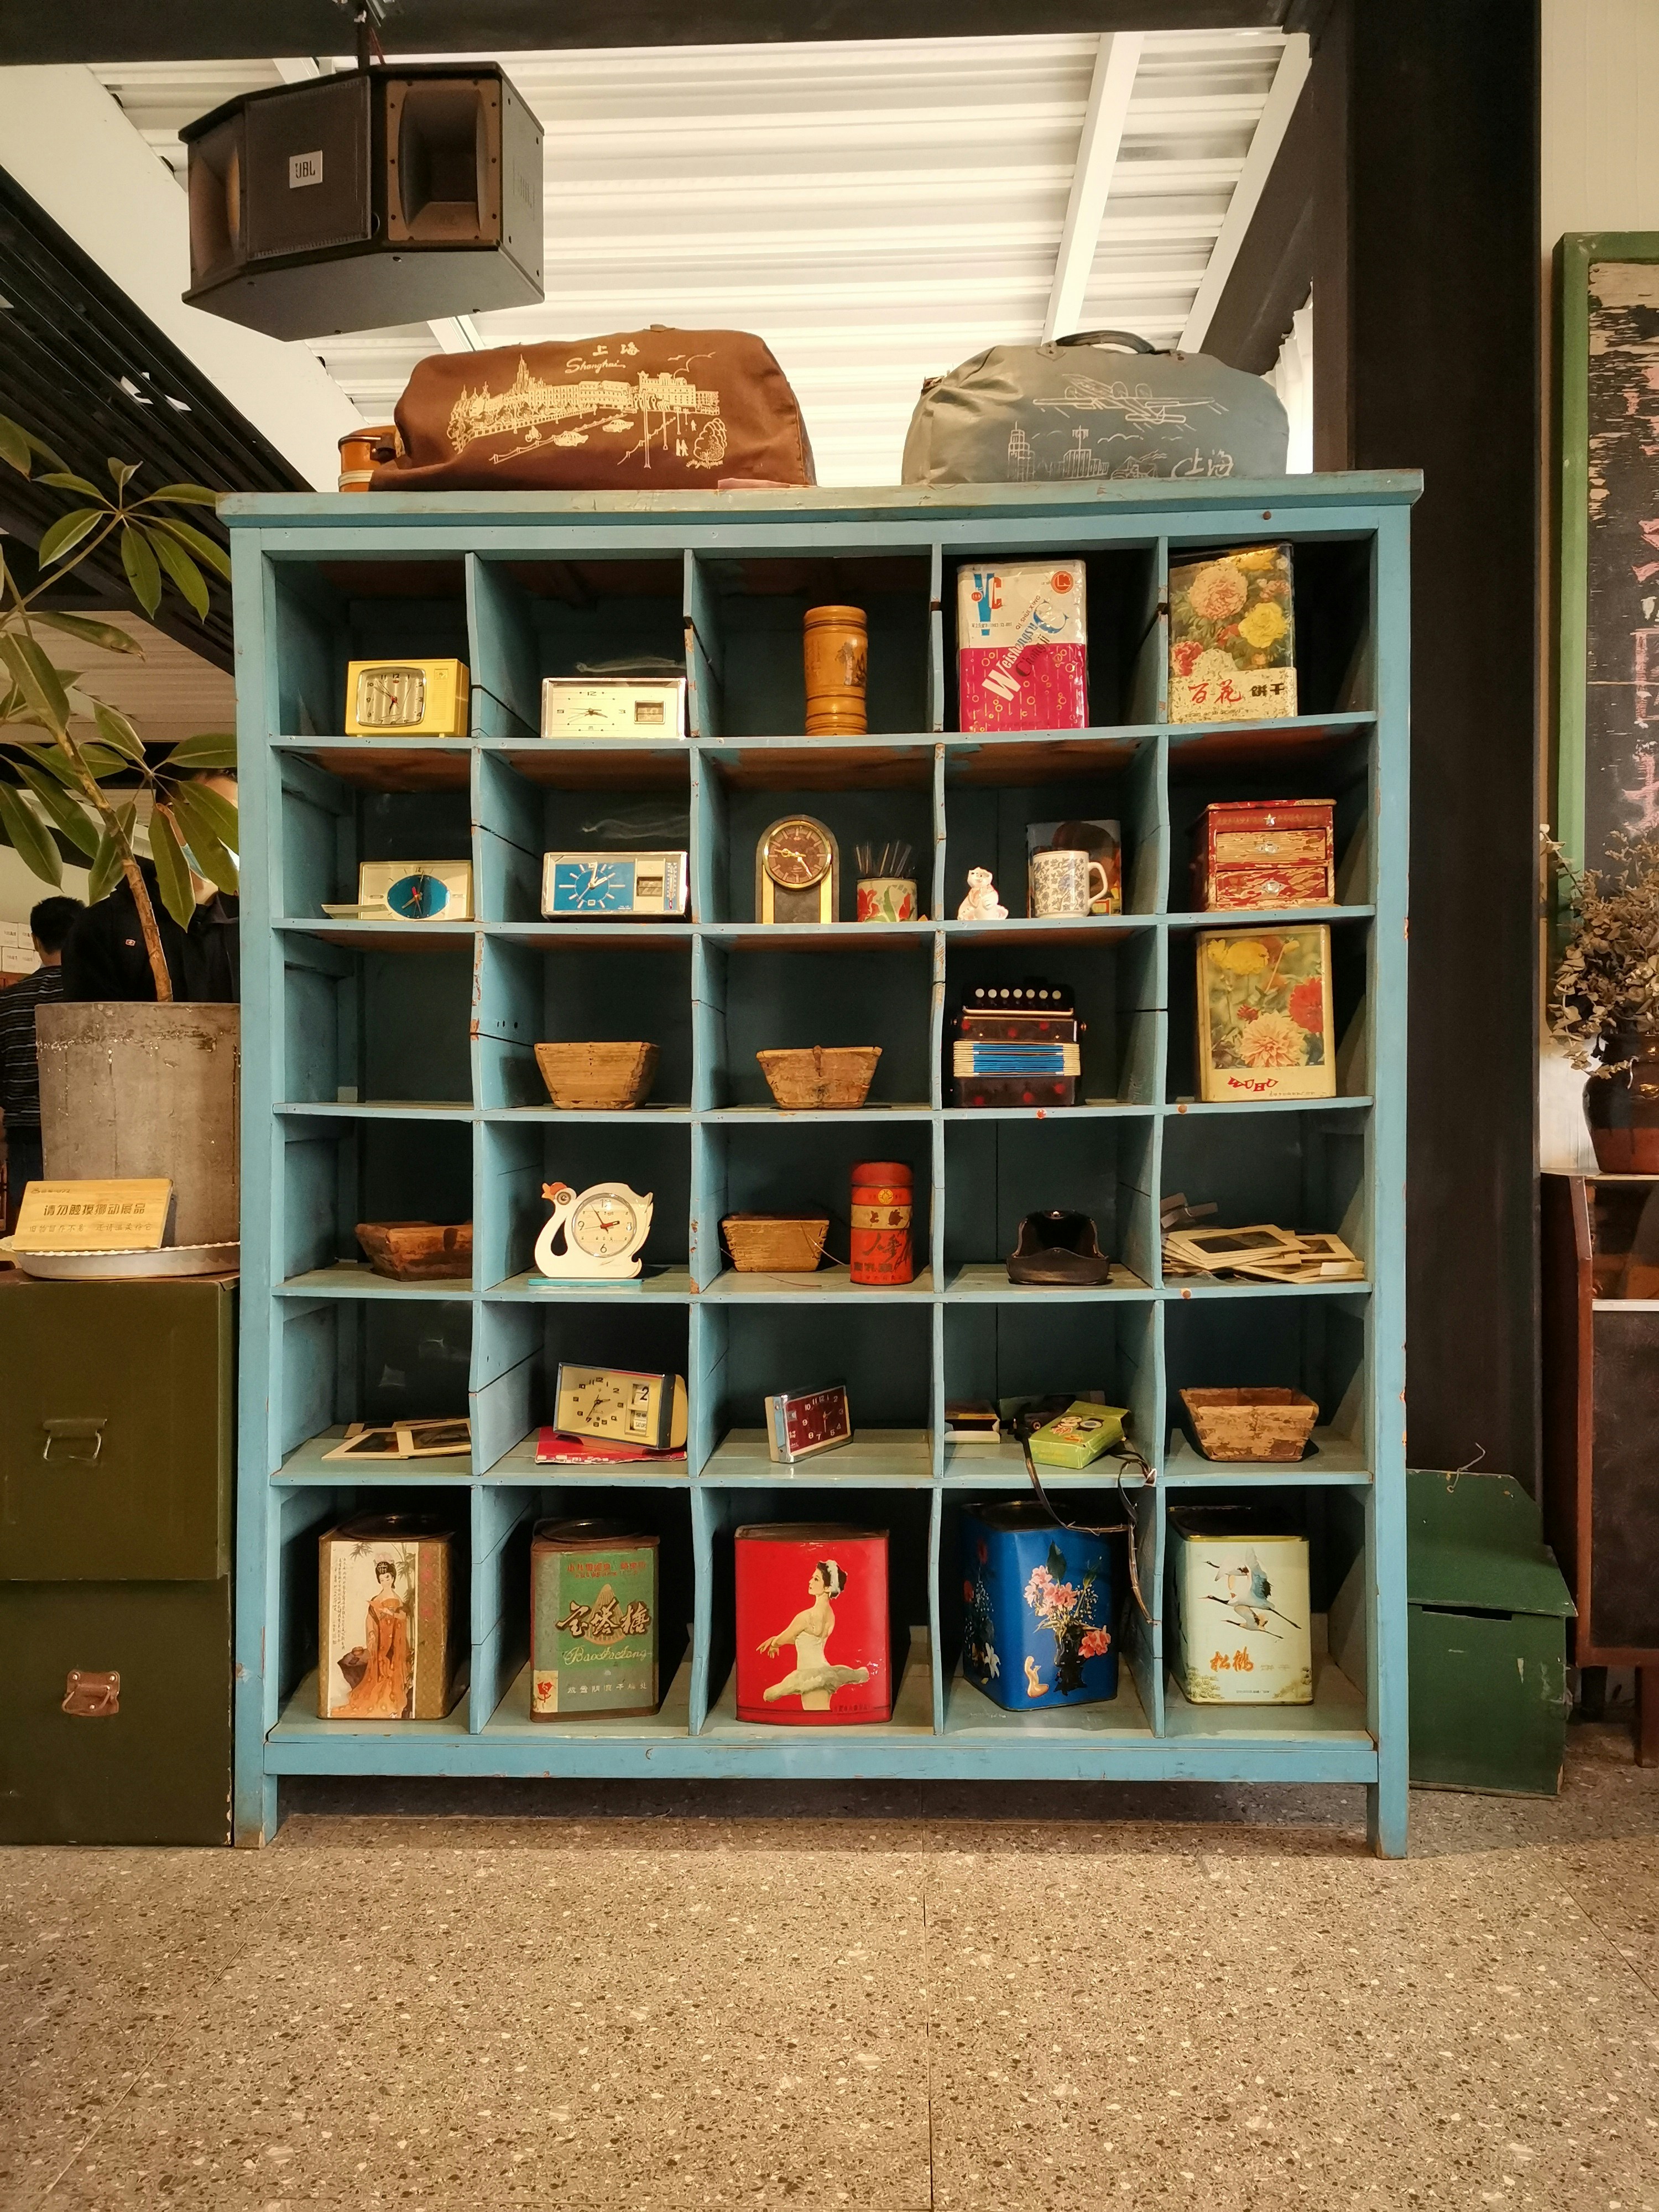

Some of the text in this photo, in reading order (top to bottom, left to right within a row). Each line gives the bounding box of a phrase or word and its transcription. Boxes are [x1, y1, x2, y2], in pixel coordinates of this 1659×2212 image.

[295, 160, 316, 179] JBL
[564, 357, 626, 374] Shanghai
[43, 1203, 146, 1216] 请勿触摸挪动展品
[577, 1220, 585, 1231] 9
[600, 1243, 607, 1253] 6
[639, 1386, 649, 1401] 2
[819, 1395, 825, 1403] 12
[816, 1432, 822, 1441] 7
